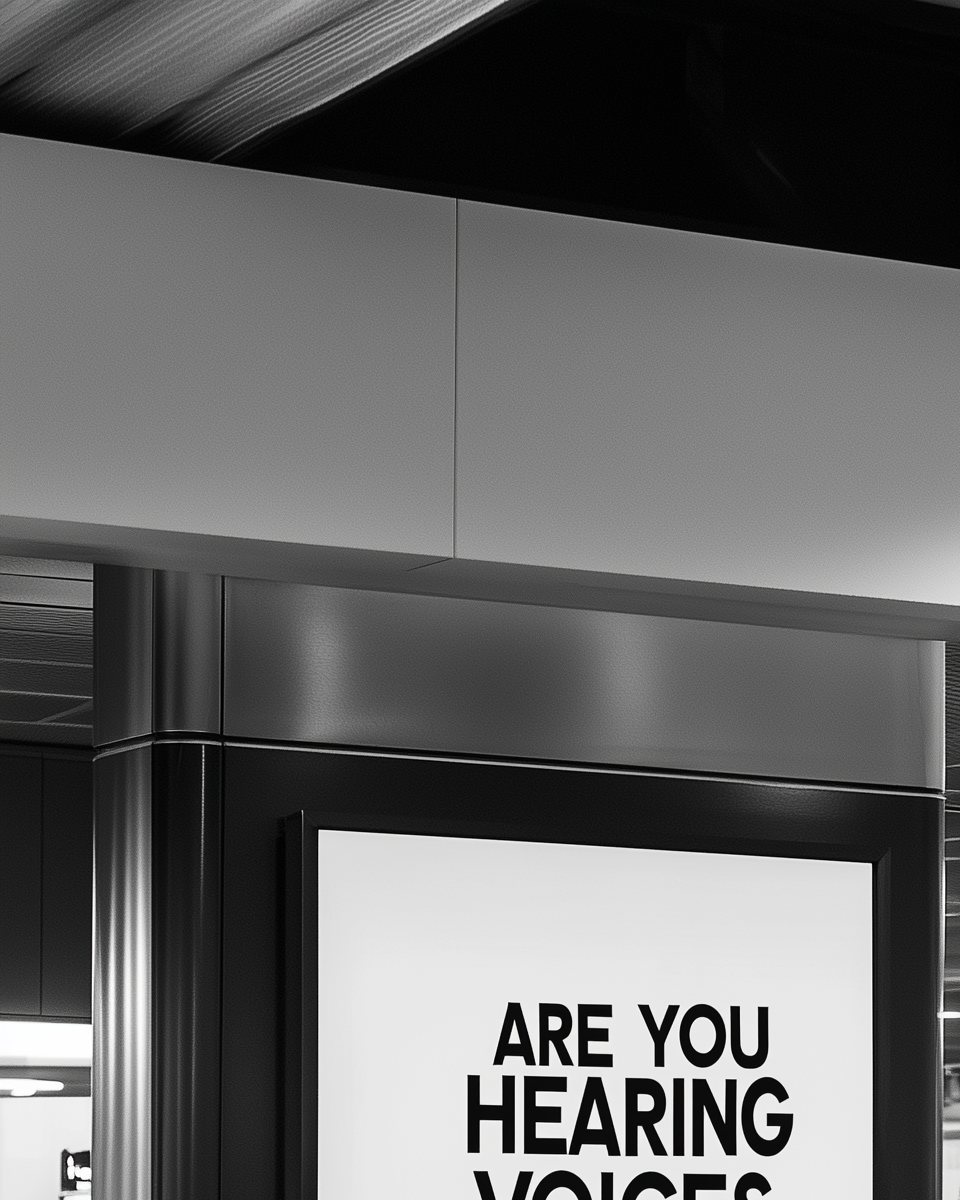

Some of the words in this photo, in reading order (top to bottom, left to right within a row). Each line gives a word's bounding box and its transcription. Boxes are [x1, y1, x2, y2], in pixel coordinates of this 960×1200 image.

[493, 1002, 613, 1067] ARE
[638, 1004, 768, 1069] YOU
[467, 1074, 794, 1157] HEARING
